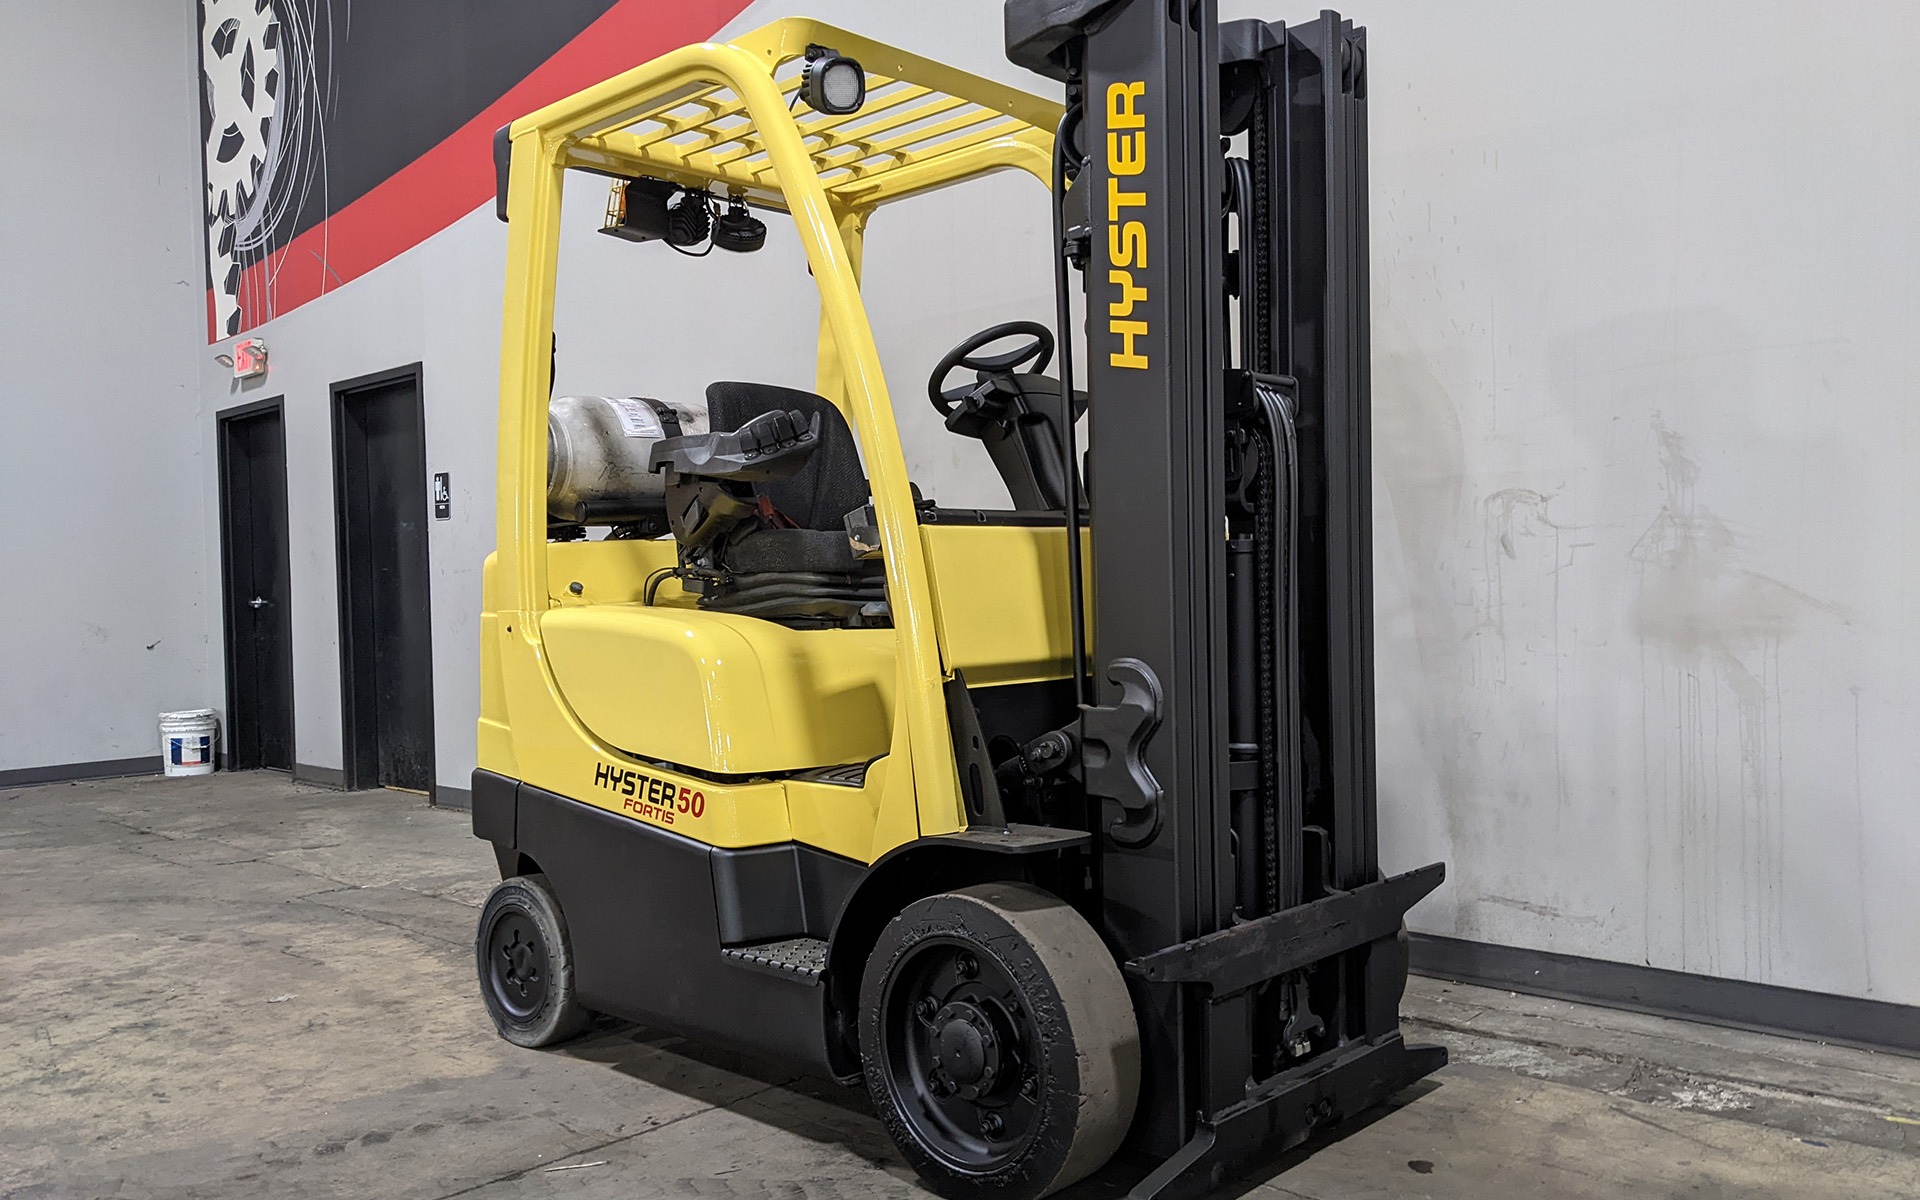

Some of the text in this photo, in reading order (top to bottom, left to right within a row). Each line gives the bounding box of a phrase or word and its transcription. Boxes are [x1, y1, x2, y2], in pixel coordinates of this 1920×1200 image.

[1106, 81, 1149, 370] HYSTER
[594, 762, 706, 818] HYSTER 50
[623, 798, 674, 825] FORTIS
